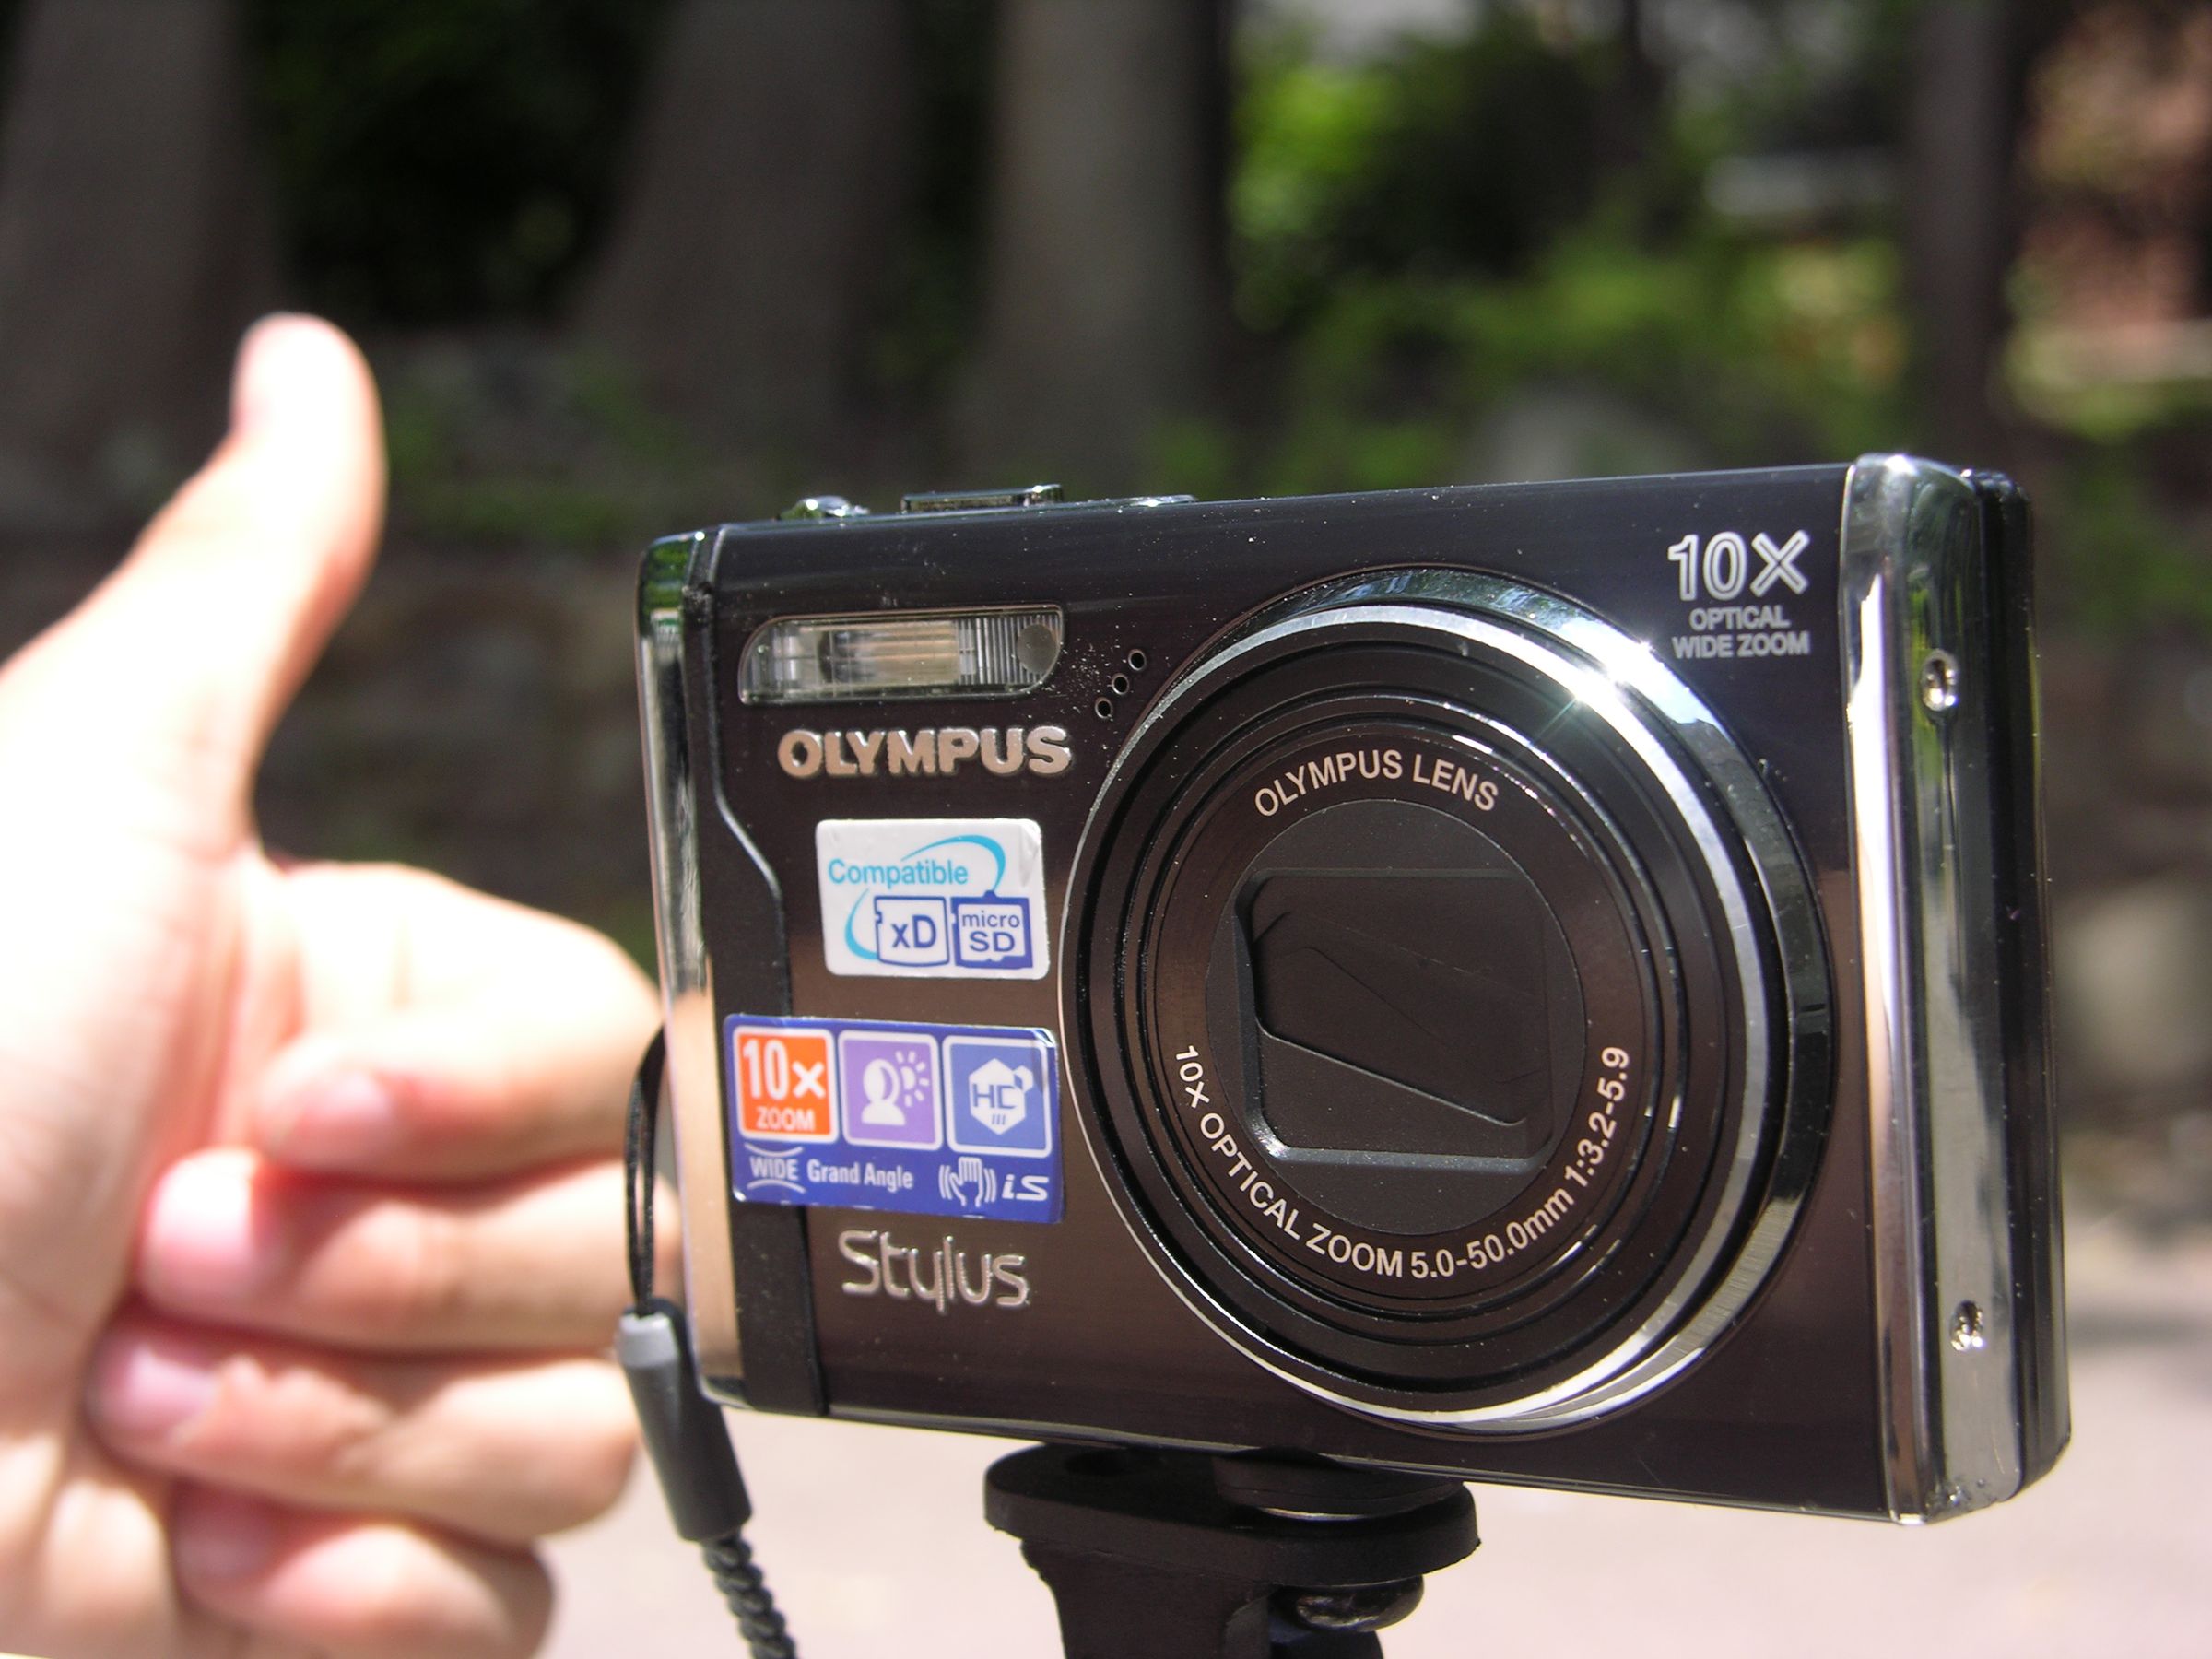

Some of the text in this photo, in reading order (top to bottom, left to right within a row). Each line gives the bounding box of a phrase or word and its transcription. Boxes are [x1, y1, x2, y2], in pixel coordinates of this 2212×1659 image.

[1688, 604, 1792, 631] OPTICAL
[1671, 630, 1810, 659] WIDE ZOOM
[777, 725, 1074, 778] OLYMPUS
[1254, 749, 1500, 817] OLYMPUS LENS
[829, 858, 969, 888] Compatible
[891, 914, 937, 948] xD
[961, 910, 1020, 928] micro
[970, 932, 1016, 952] SD
[756, 1106, 816, 1132] ZOOM
[749, 1156, 914, 1193] WIDE Grand Angle
[1199, 1112, 1301, 1240] OPTICAL
[1305, 1222, 1403, 1278] ZOOM
[1410, 1186, 1576, 1279] 5.0-50.0mm
[1564, 1046, 1630, 1188] 1:3.2-5.9
[839, 1230, 1030, 1314] Stylus
